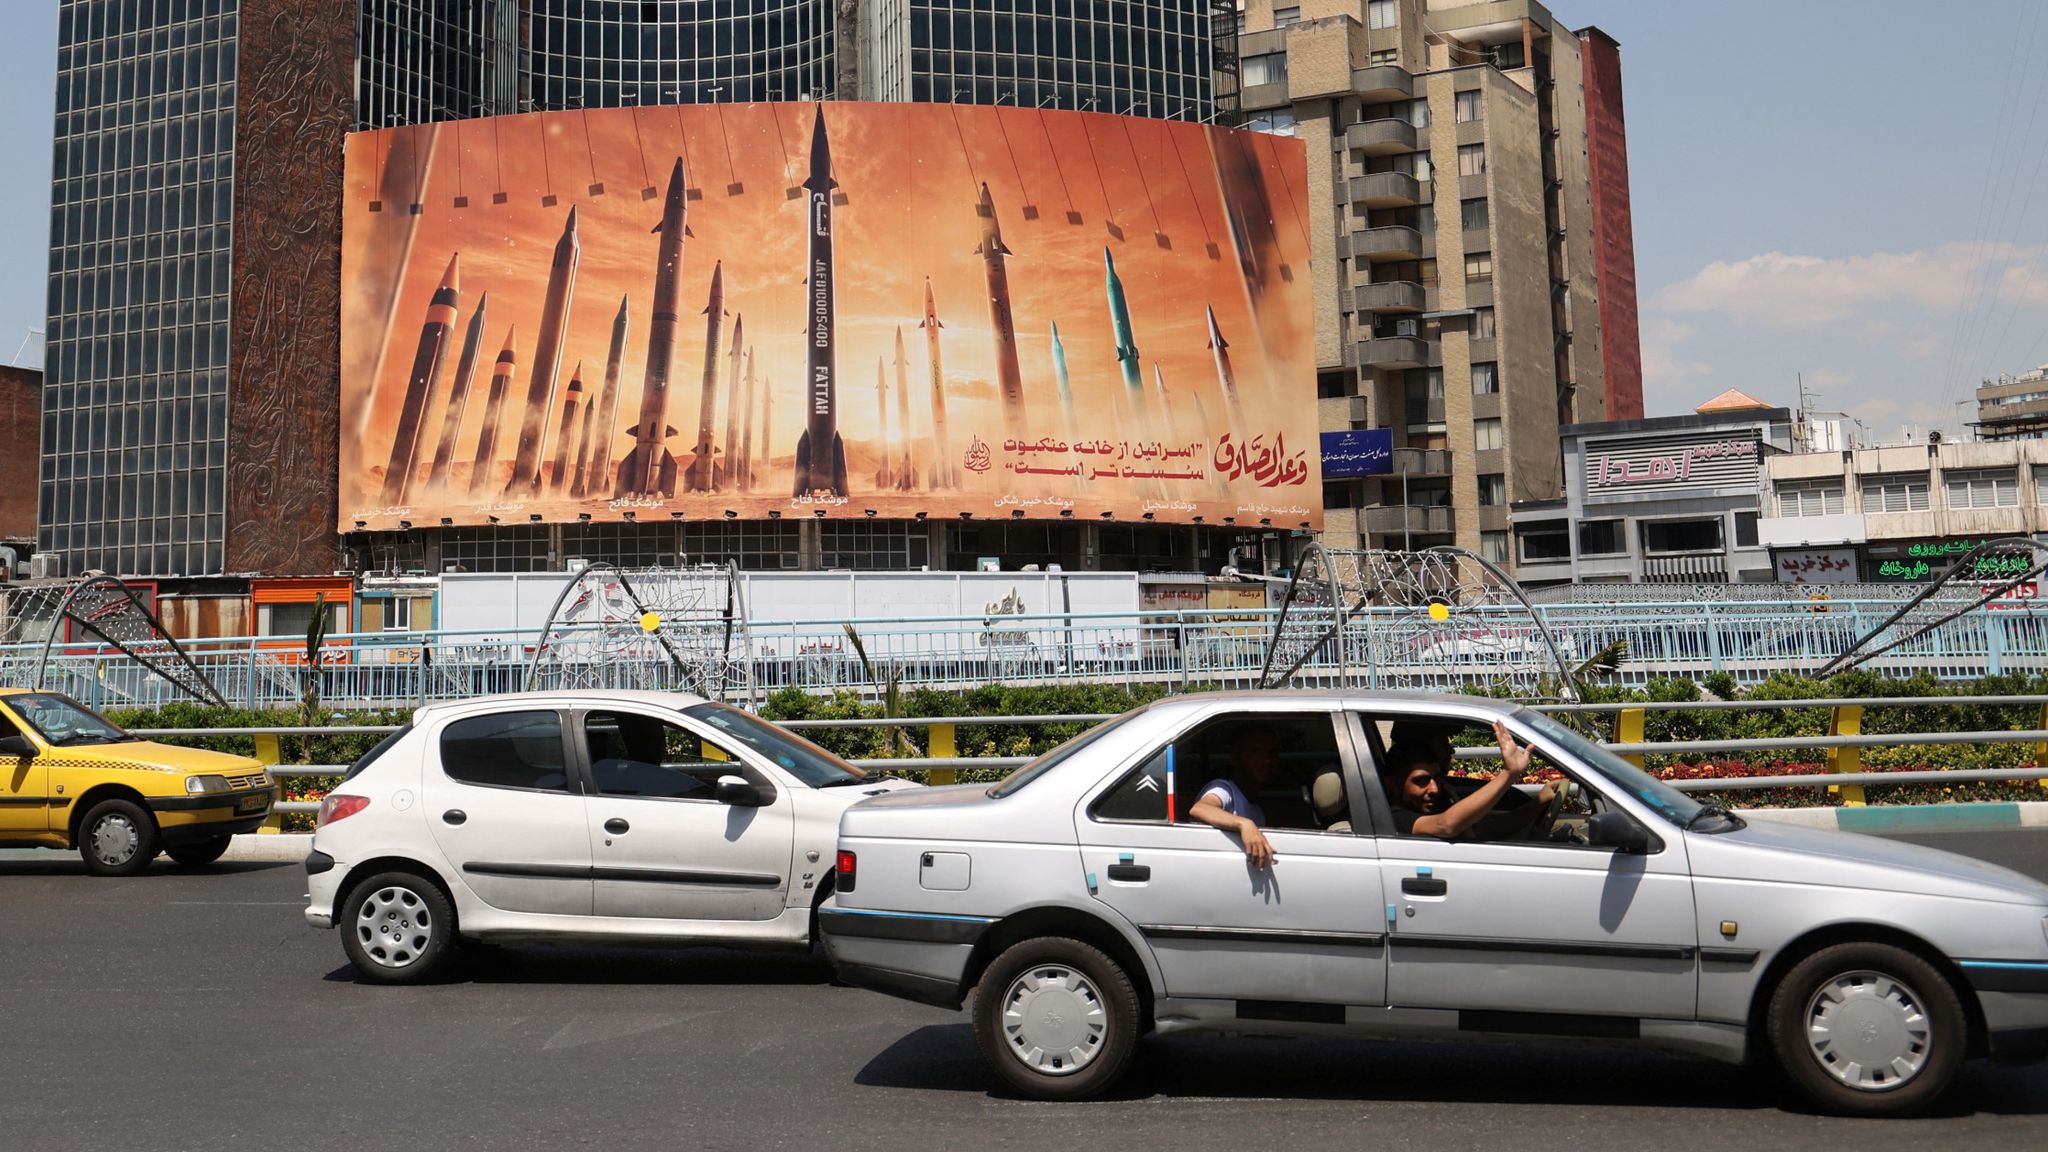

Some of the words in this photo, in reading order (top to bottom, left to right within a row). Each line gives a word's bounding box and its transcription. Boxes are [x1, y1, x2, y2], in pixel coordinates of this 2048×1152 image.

[815, 365, 828, 415] FATTAH
[1003, 437, 1069, 457] عنکبوت
[1073, 439, 1115, 456] خانه
[1117, 442, 1129, 460] از
[1088, 464, 1119, 481] تر
[1599, 450, 1692, 484] اهدا
[608, 497, 629, 512] فاتح
[631, 497, 664, 509] موشک
[791, 493, 813, 509] فتاح
[815, 495, 849, 507] موشک
[1019, 495, 1042, 507] خیبر
[1043, 496, 1075, 509] موشک
[1142, 499, 1169, 511] سجیل
[1170, 500, 1198, 512] موشک
[1289, 505, 1311, 516] موشک
[1782, 555, 1816, 576] خرید
[1816, 555, 1850, 573] مرکز
[1879, 560, 1929, 580] داروخانه
[1975, 556, 2029, 572] داروخانه
